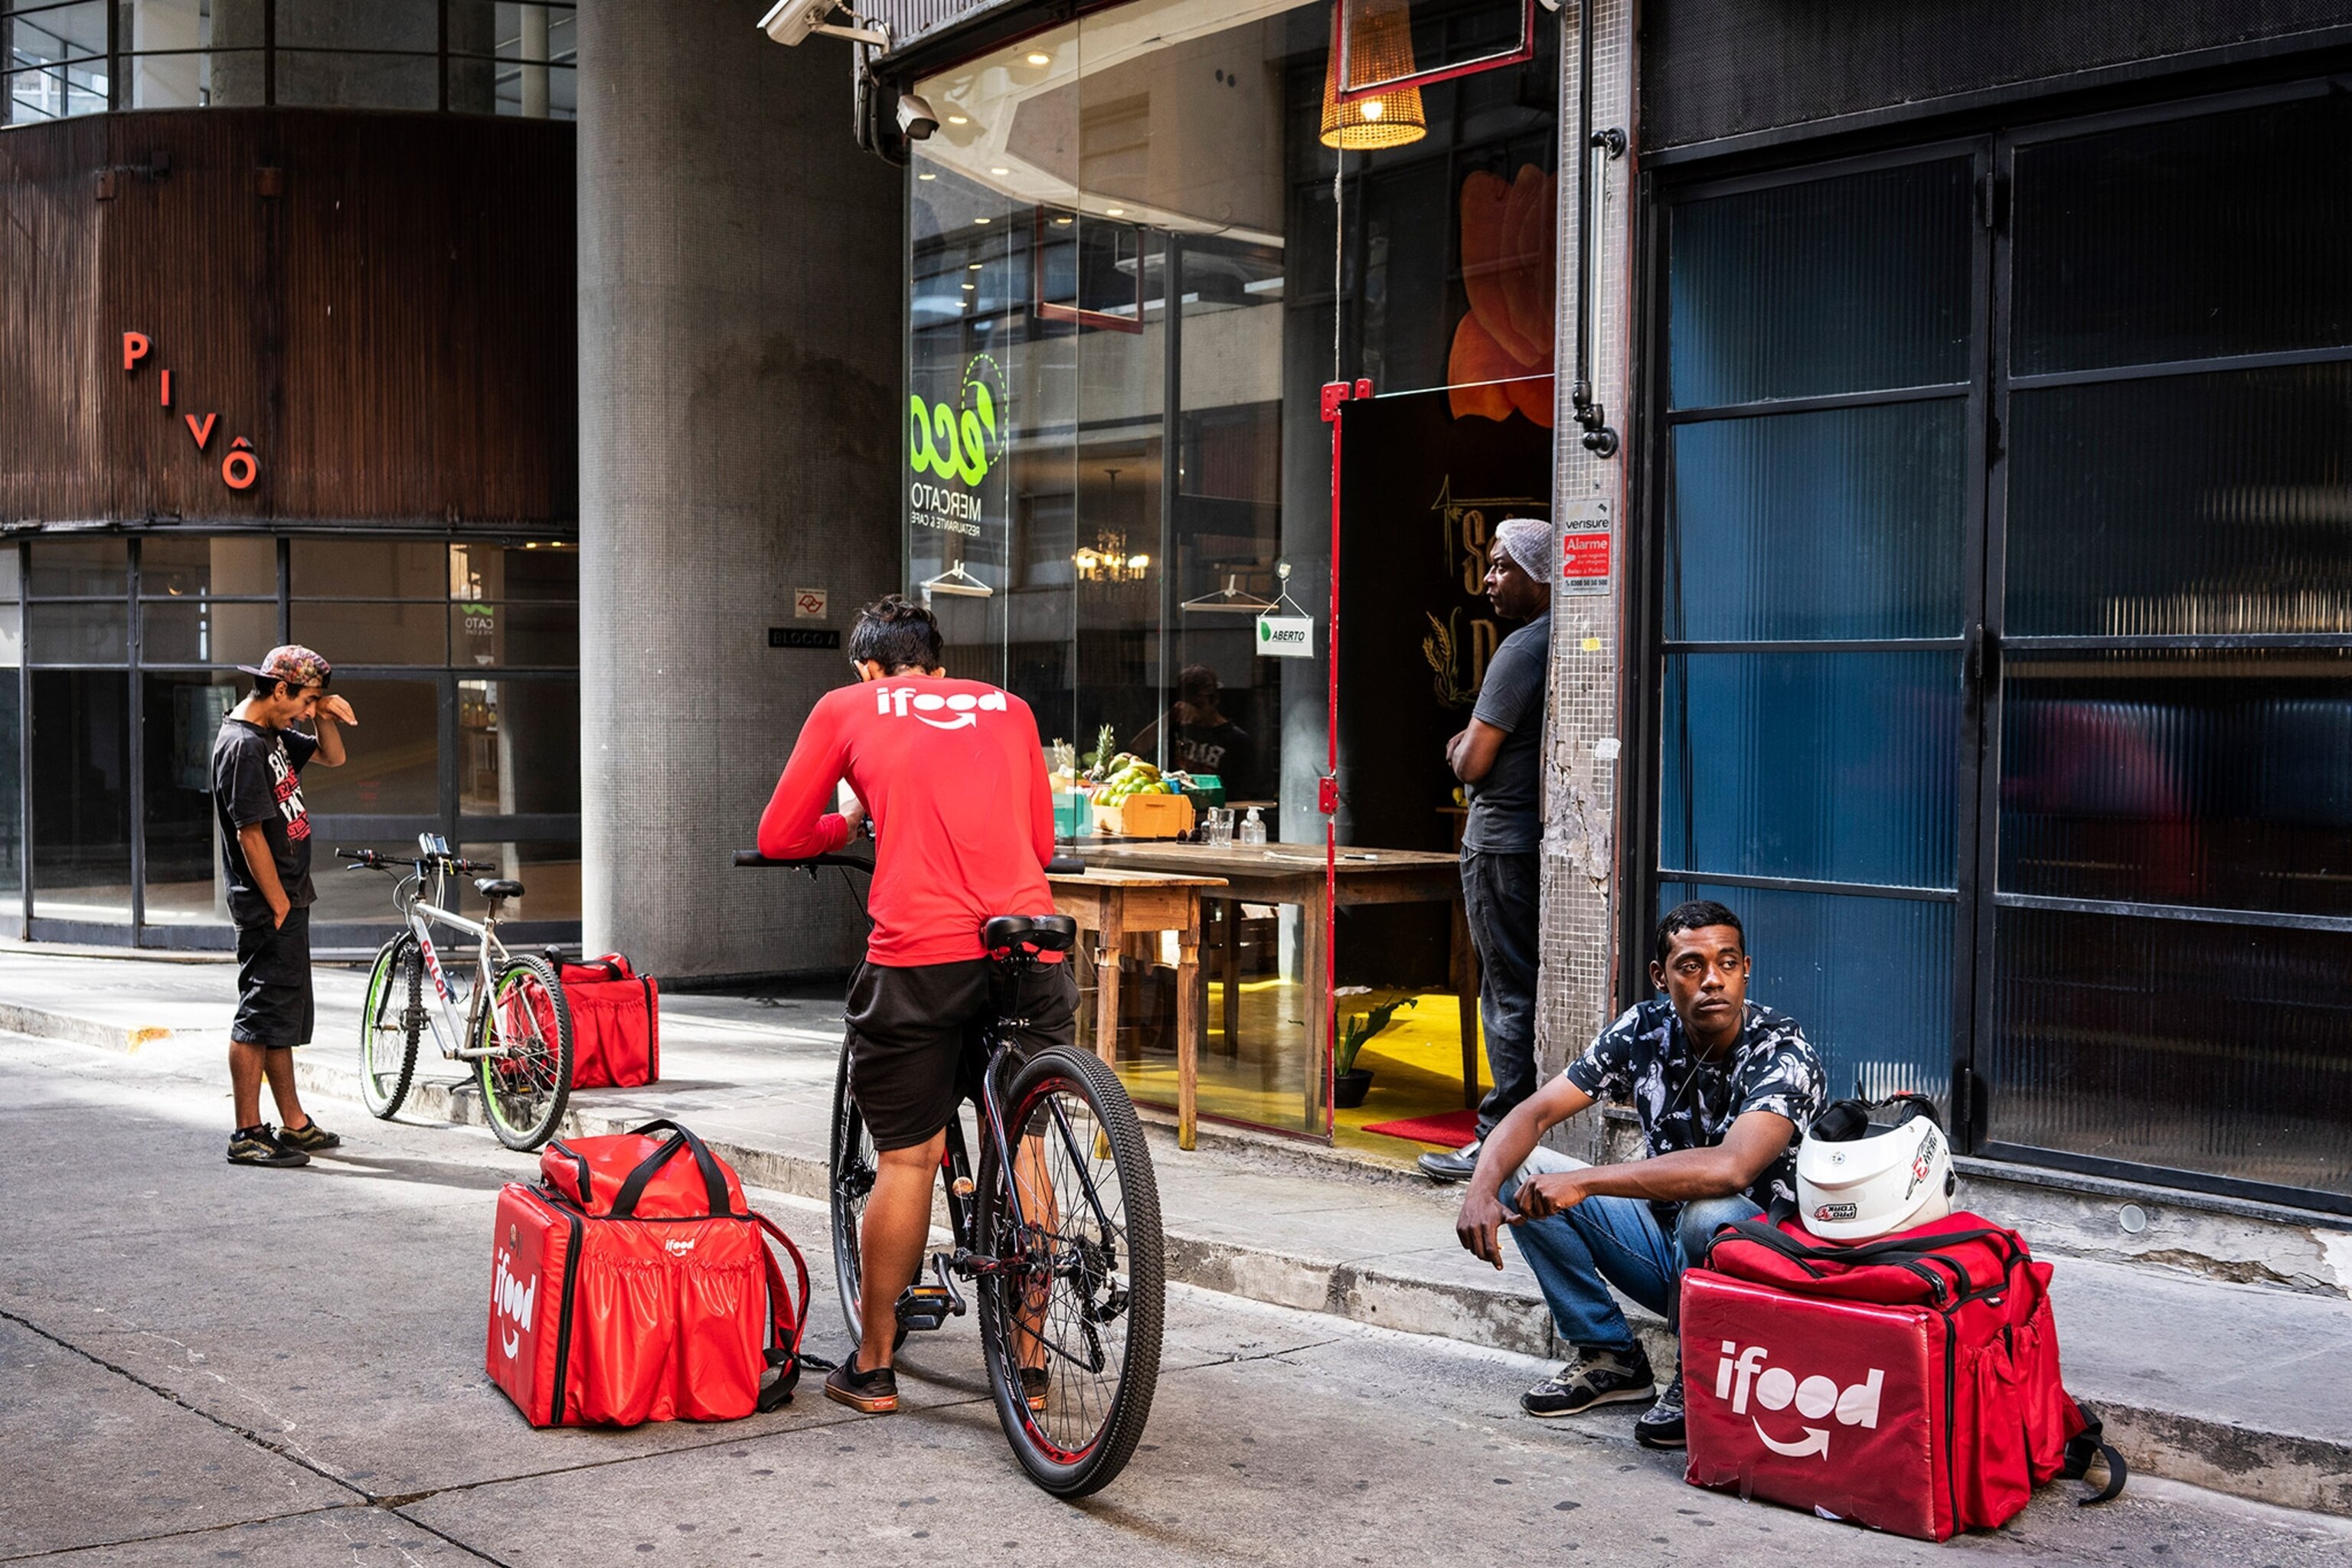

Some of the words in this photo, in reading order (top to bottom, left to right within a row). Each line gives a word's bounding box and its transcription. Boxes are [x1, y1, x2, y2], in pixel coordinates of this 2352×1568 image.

[123, 332, 257, 489] PIVÔ
[1566, 519, 1609, 529] verisure
[1566, 537, 1608, 551] Alarme
[773, 631, 824, 645] BLOCO
[827, 633, 838, 645] A
[1272, 630, 1305, 642] ABERTO
[877, 687, 1007, 717] ifood
[422, 940, 449, 1001] CALOI
[665, 1237, 695, 1252] ifood
[494, 1247, 536, 1333] ifood
[1716, 1340, 1884, 1429] ifood
